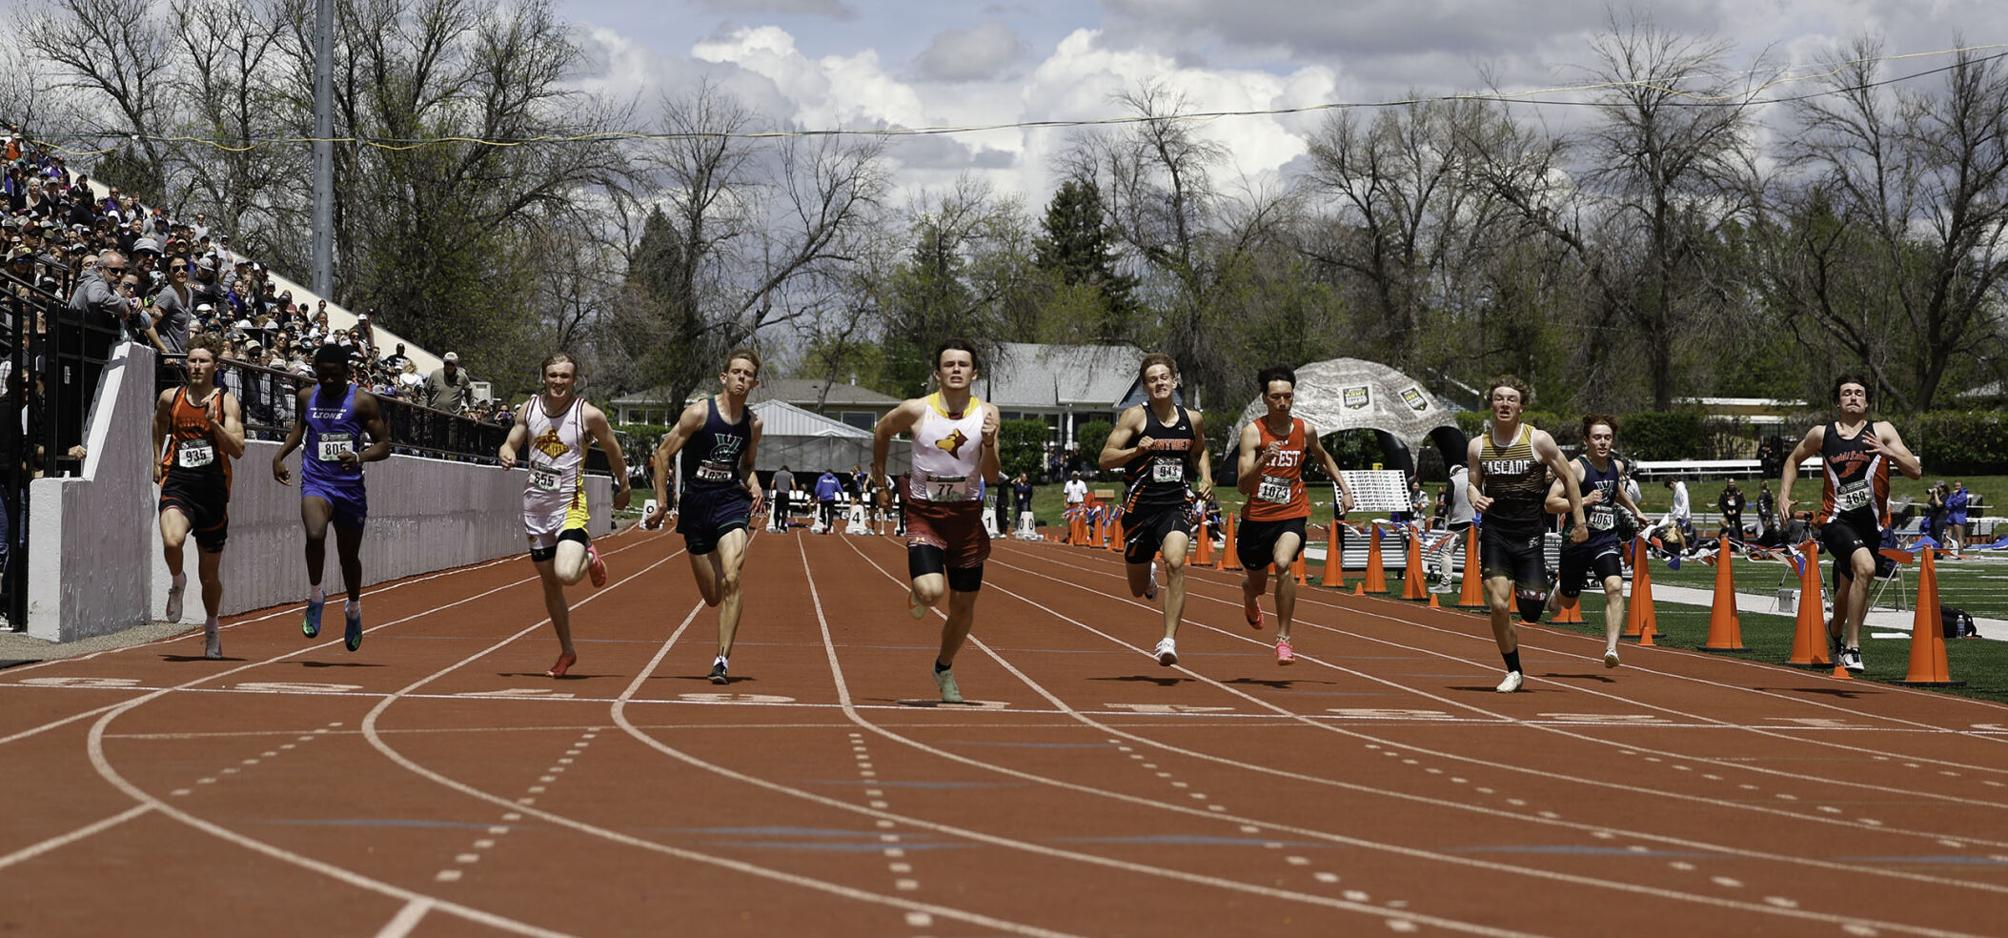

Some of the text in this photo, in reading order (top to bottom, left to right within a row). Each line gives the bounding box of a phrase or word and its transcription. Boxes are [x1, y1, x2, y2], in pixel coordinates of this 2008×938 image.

[312, 411, 343, 420] LIONS
[325, 443, 346, 456] 805
[185, 449, 207, 463] 935
[1482, 460, 1531, 475] CASCADE
[938, 484, 955, 496] 77
[1262, 484, 1288, 499] 1073
[852, 512, 860, 524] 4
[986, 517, 992, 528] 1
[1593, 513, 1612, 525] 1063
